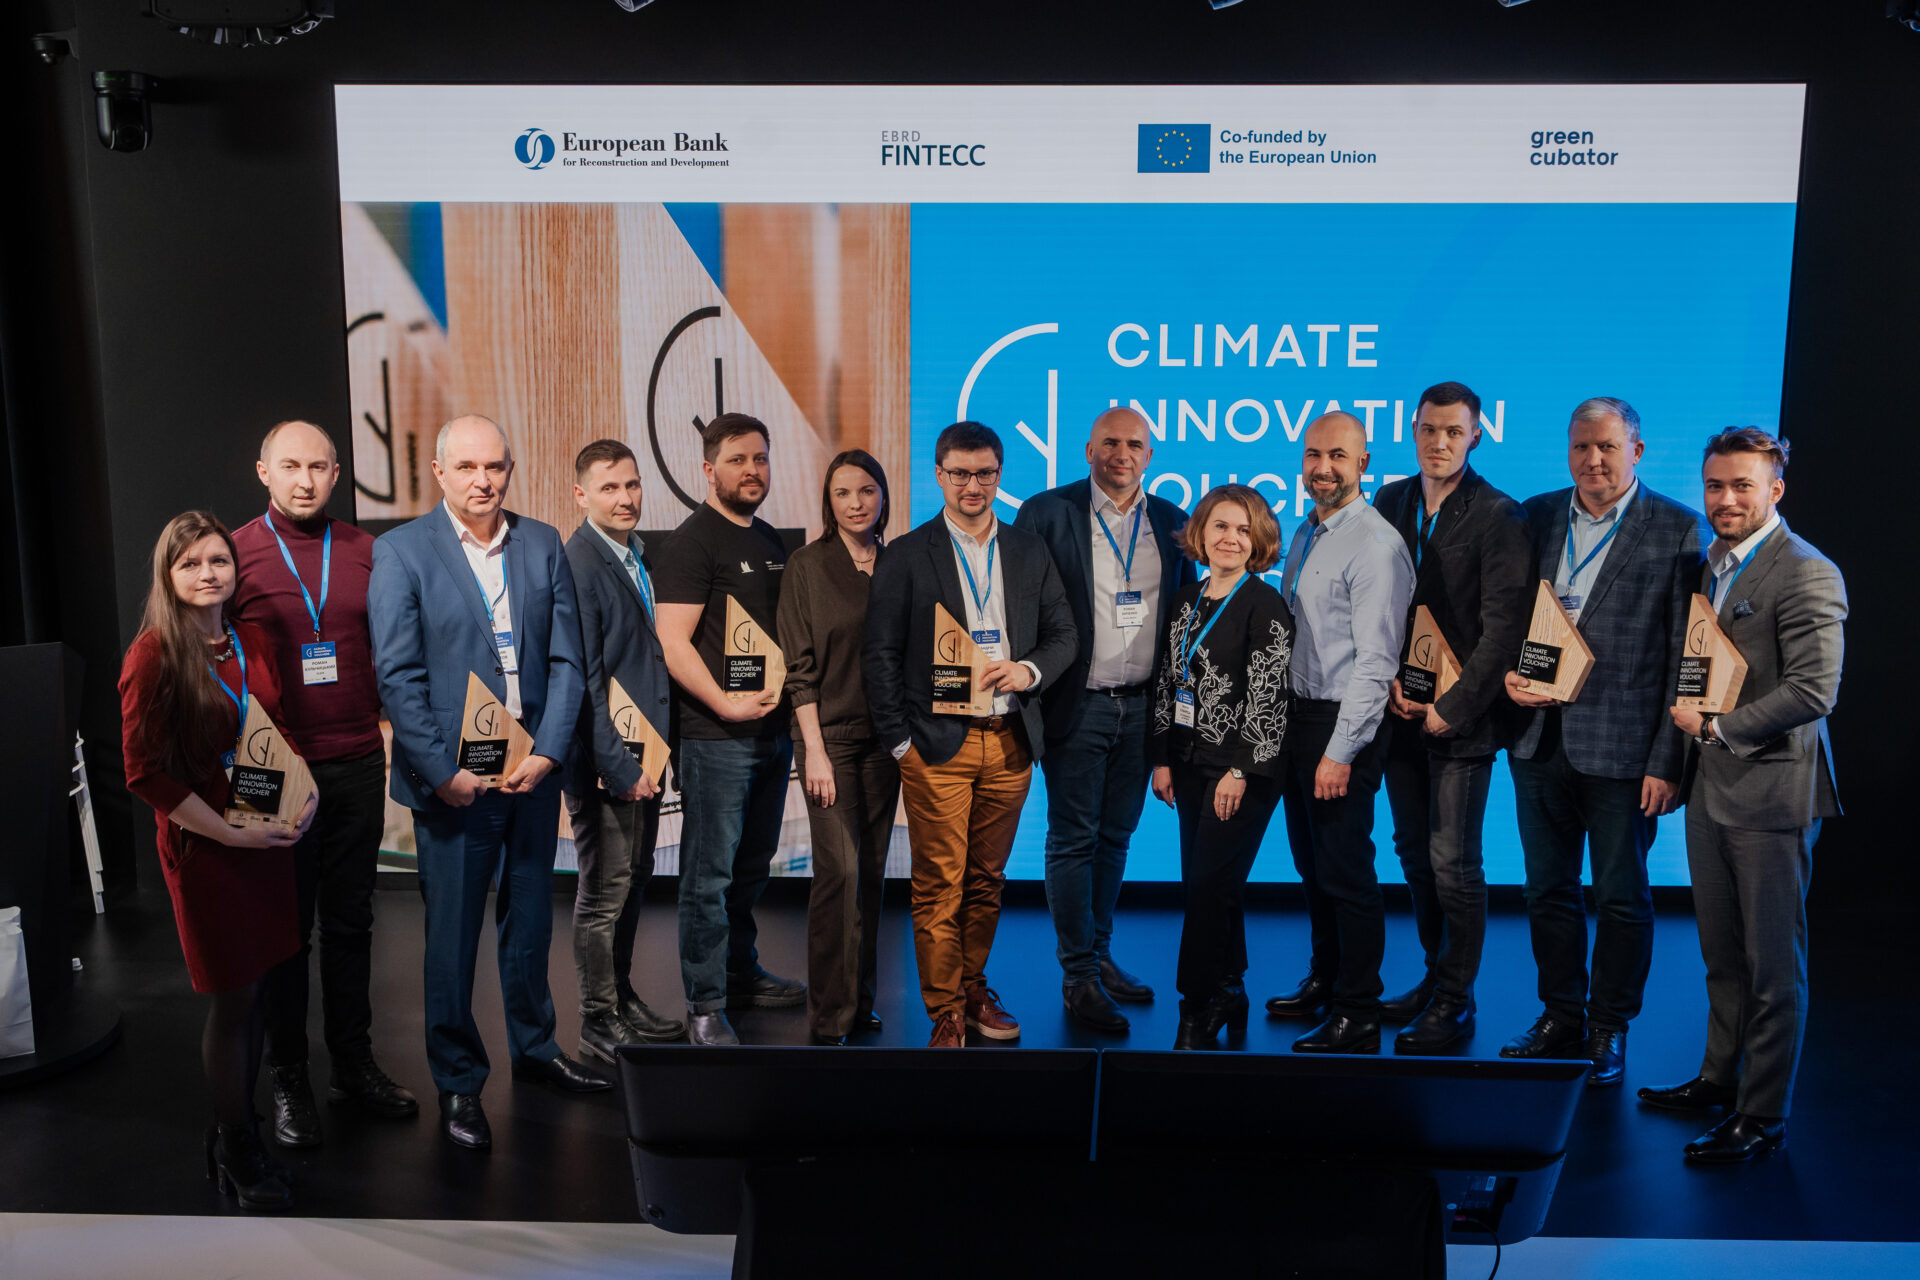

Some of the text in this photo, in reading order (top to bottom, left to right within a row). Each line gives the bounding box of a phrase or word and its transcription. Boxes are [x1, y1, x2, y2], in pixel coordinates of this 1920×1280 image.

[563, 133, 728, 155] European Bank
[881, 130, 920, 143] EBRD
[1220, 130, 1327, 146] Co-funded by
[1531, 131, 1593, 149] green
[563, 156, 728, 168] for Reconstruction and Development
[881, 144, 986, 166] FINTECC
[1219, 150, 1376, 166] the European Union
[1530, 148, 1619, 166] cubator
[1107, 322, 1379, 368] CLIMATE
[1110, 398, 1505, 443] NNOVTIN
[1140, 472, 1411, 517] OCHE
[1524, 652, 1555, 664] INNOVATION
[1525, 646, 1548, 655] CLIMATE
[1524, 658, 1549, 668] VOUCHER
[238, 780, 278, 790] INNOVATION
[240, 772, 268, 782] CLIMATE
[238, 787, 270, 796] VOUCHER
